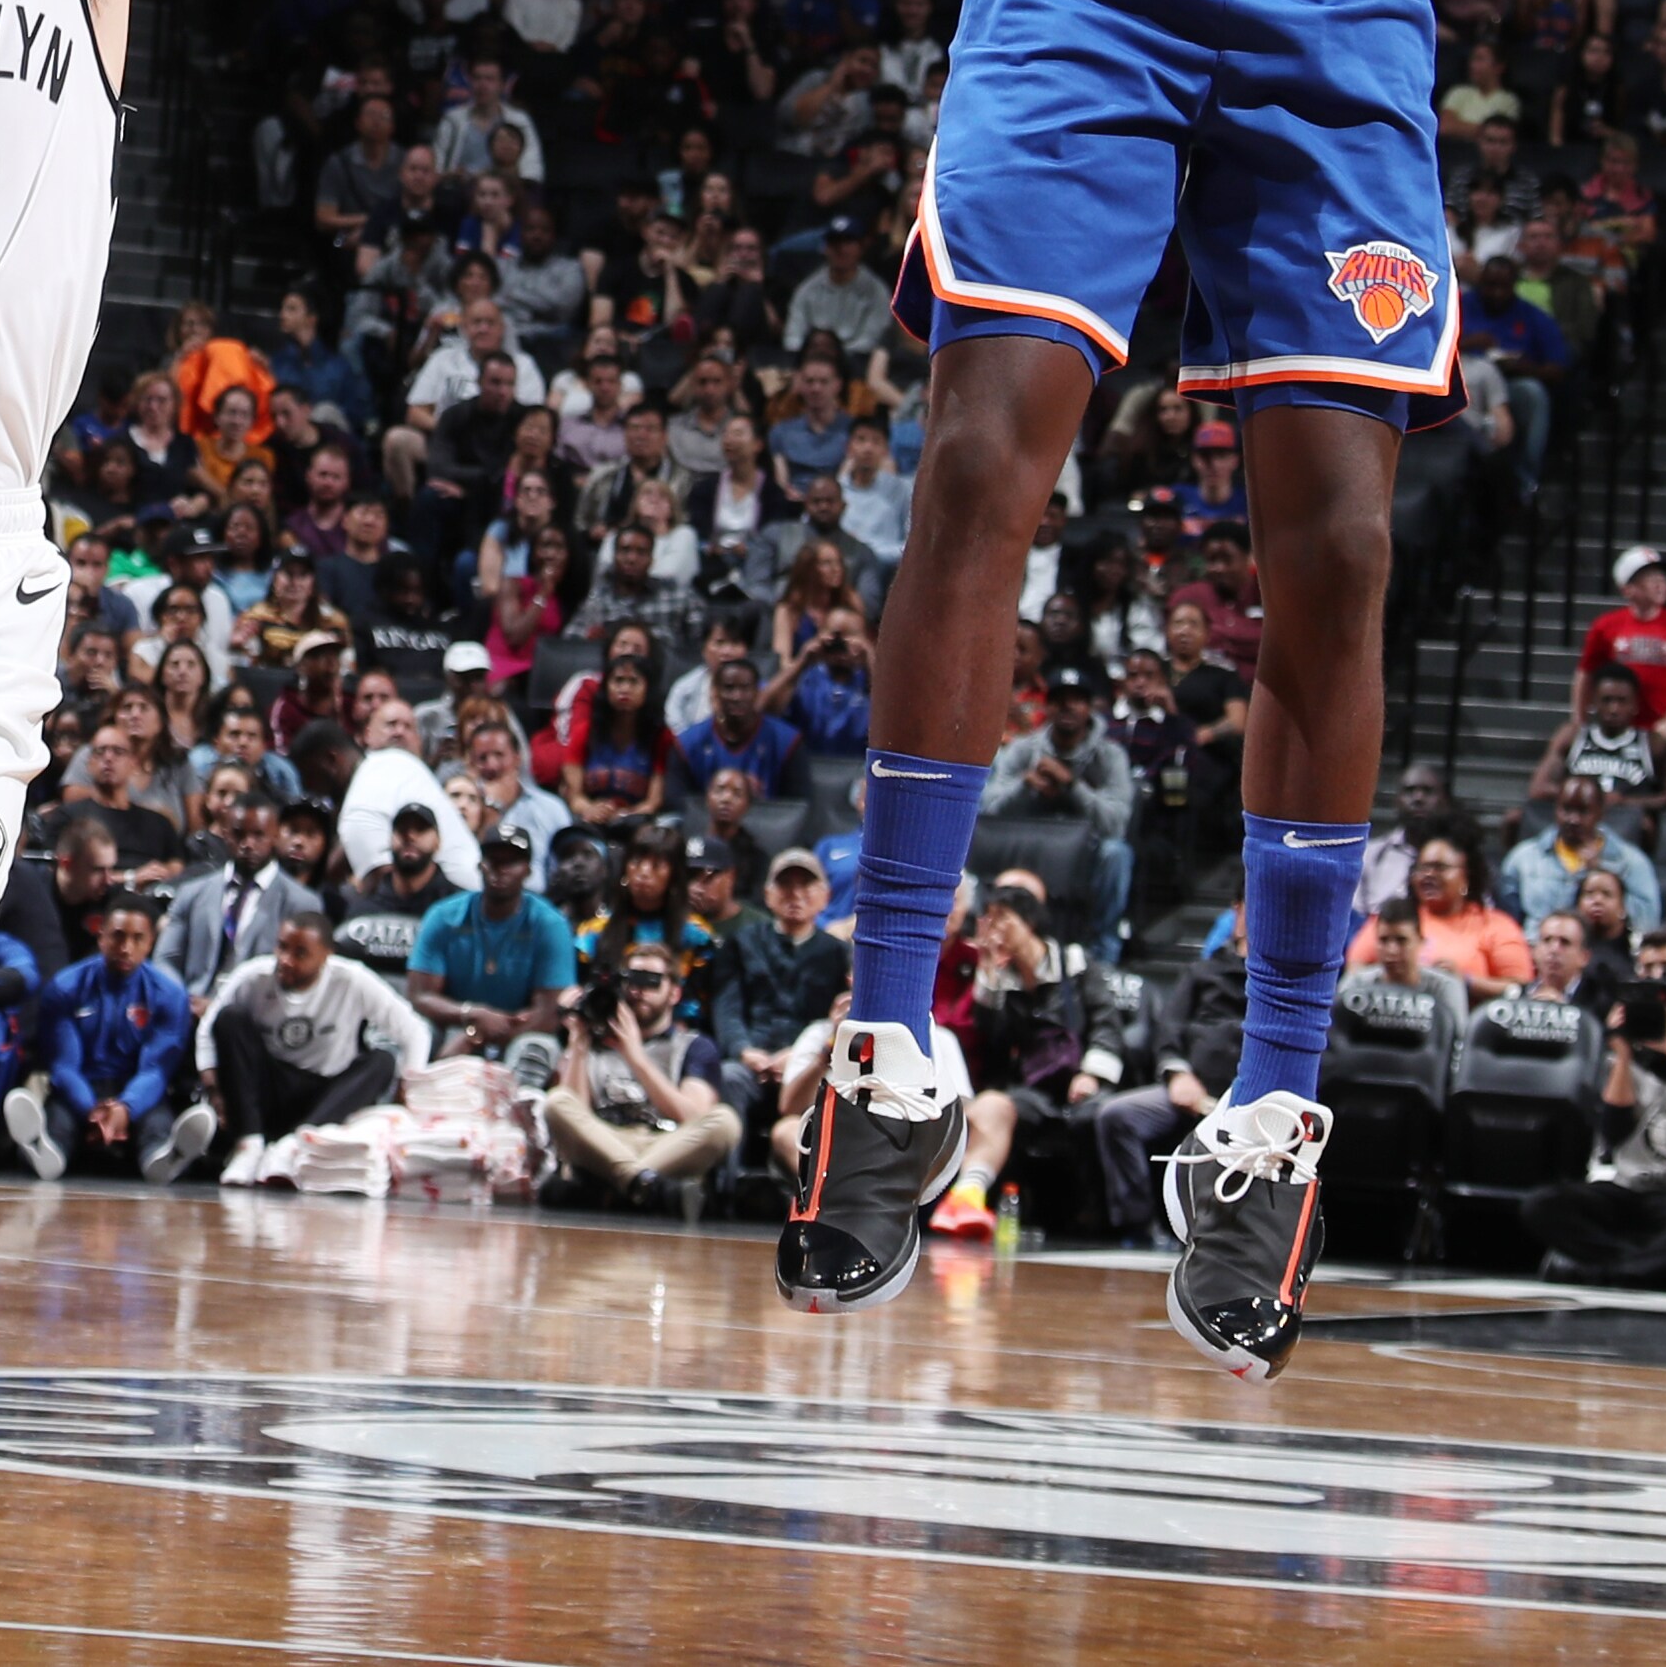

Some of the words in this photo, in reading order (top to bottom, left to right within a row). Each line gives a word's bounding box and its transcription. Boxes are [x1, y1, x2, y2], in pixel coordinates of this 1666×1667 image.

[1333, 250, 1430, 303] KNICKS
[347, 916, 421, 946] QATA
[1342, 987, 1435, 1018] QATAR
[1487, 998, 1581, 1029] QATAR
